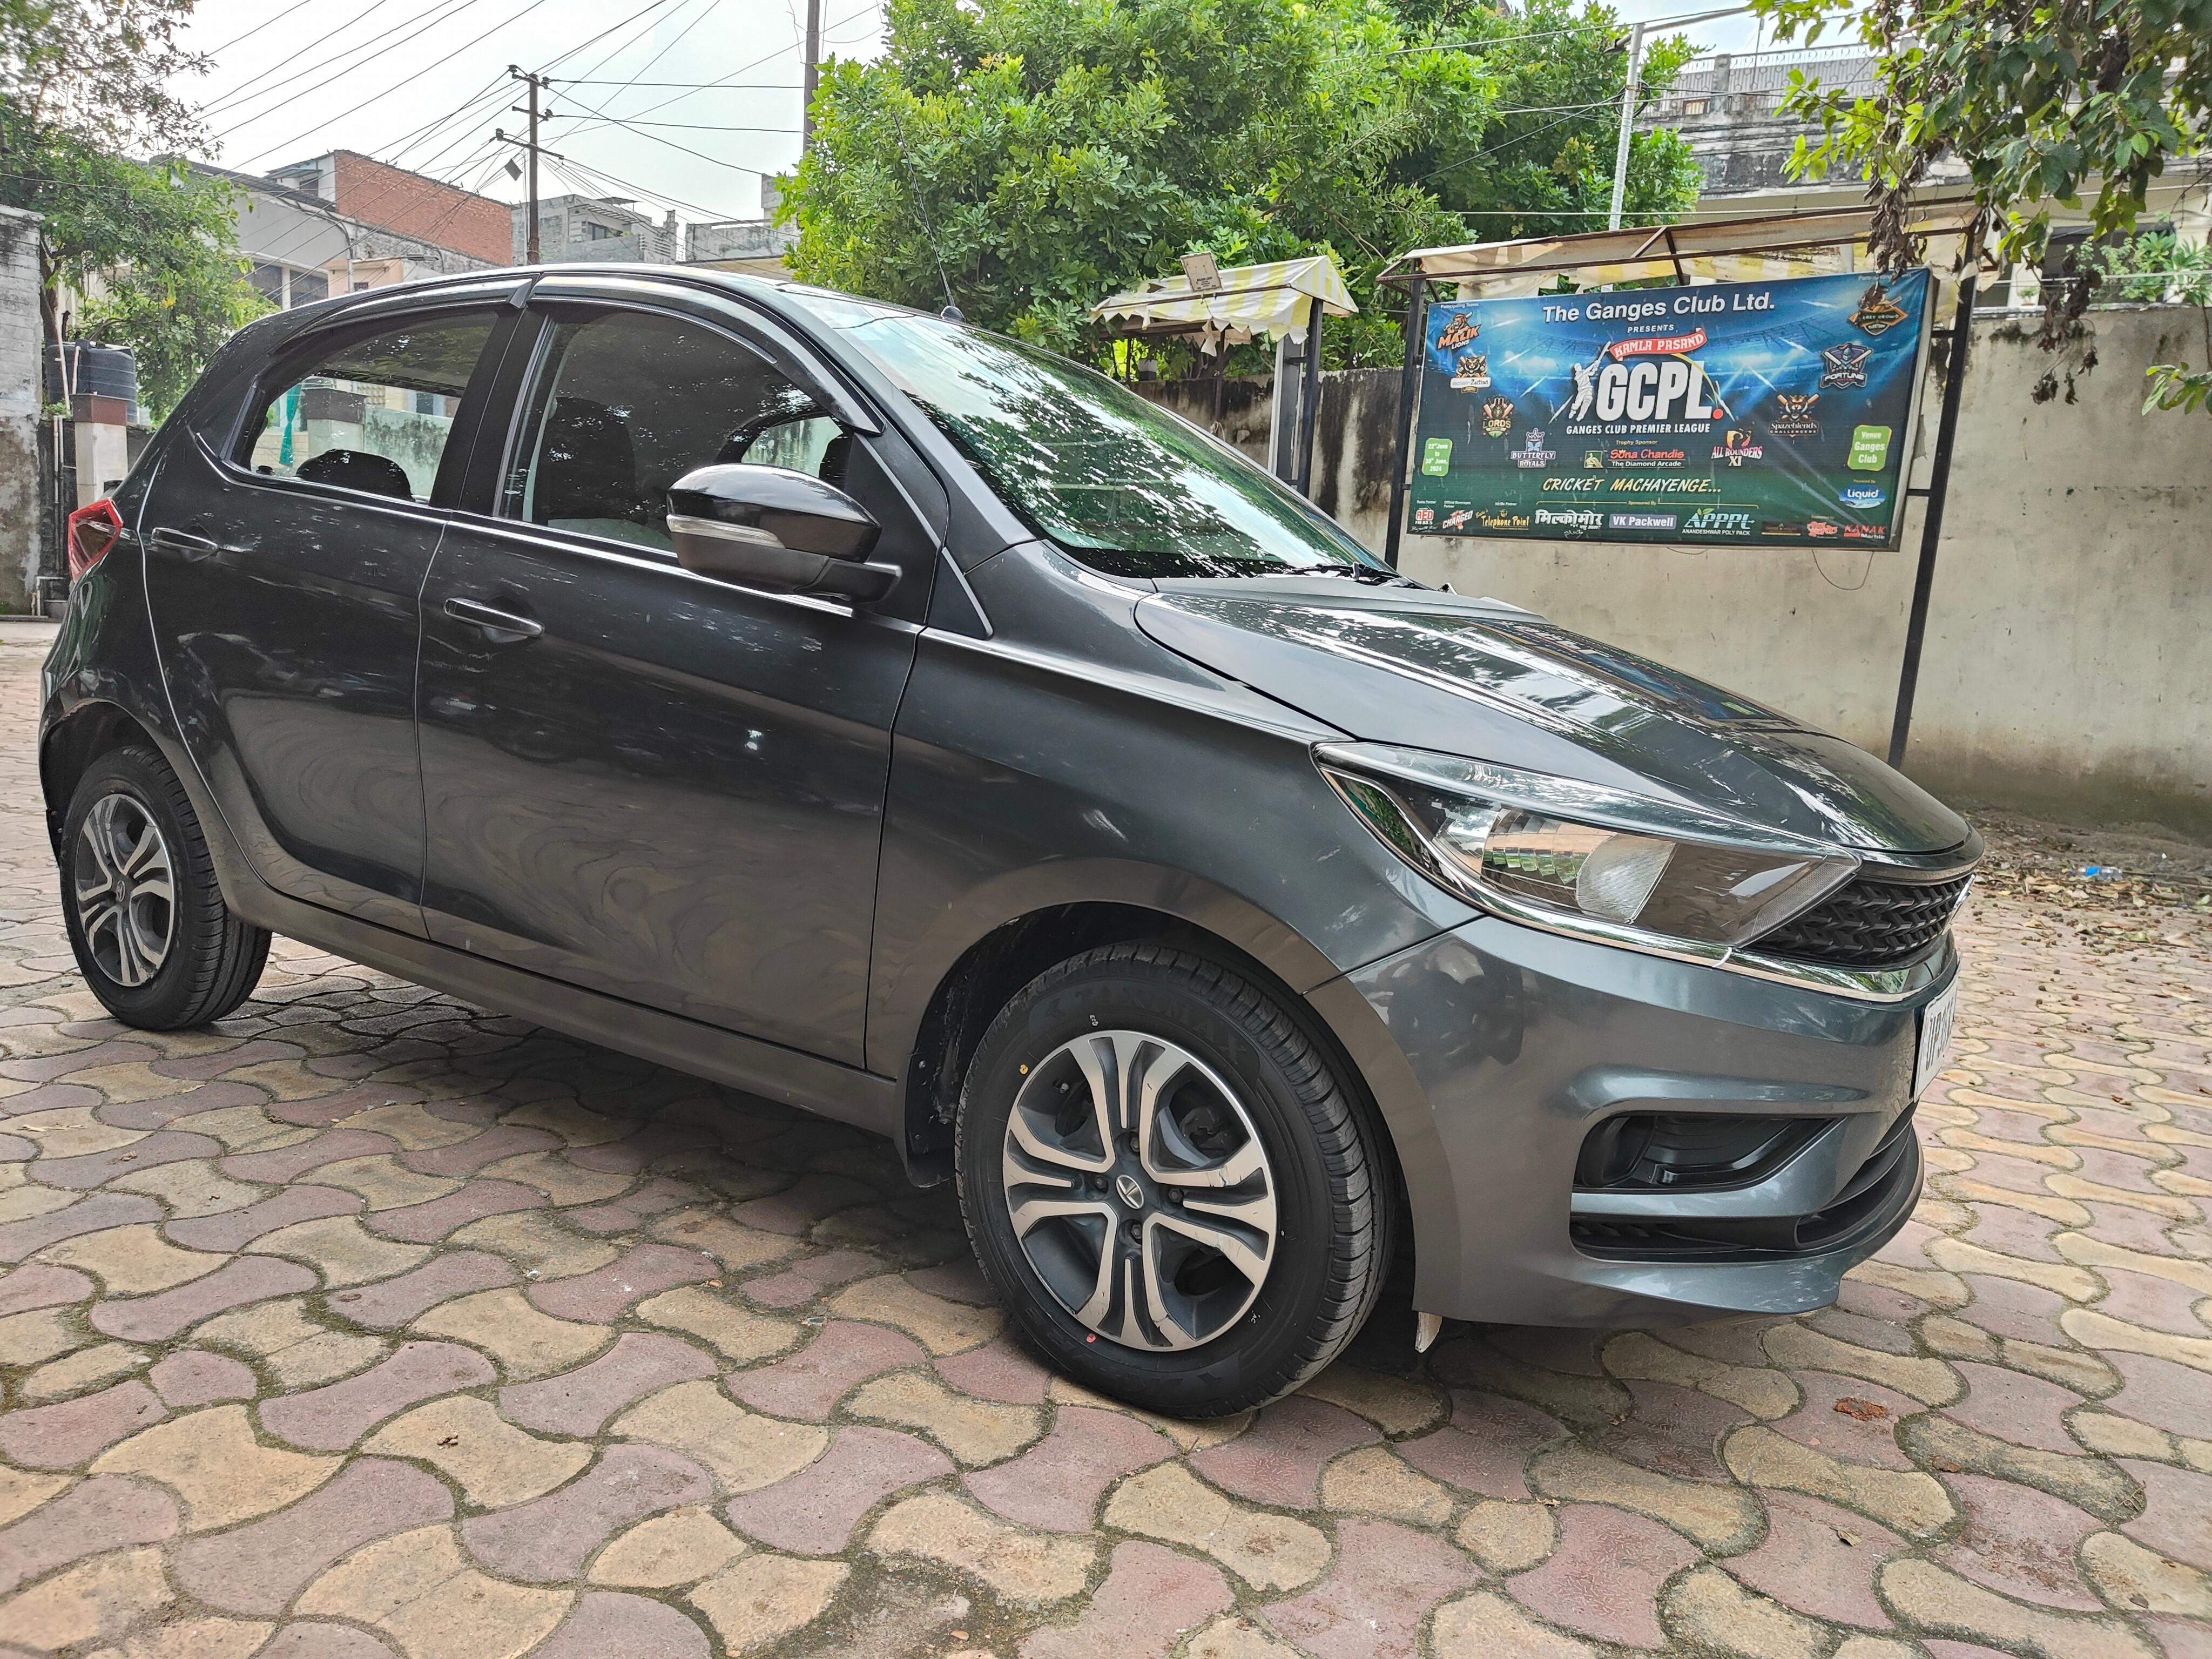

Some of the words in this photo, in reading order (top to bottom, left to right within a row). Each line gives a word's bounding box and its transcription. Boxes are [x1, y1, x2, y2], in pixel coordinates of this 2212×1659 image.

[1543, 306, 1580, 322] The
[1586, 302, 1666, 322] Ganges
[1674, 295, 1725, 313] Club
[1733, 292, 1775, 311] Ltd.
[1627, 325, 1674, 333] PRESENTS
[1438, 326, 1480, 349] MALIK
[1452, 339, 1469, 349] LIONS
[1614, 340, 1652, 358] KAMLA
[1657, 334, 1704, 351] PASAND
[1596, 360, 1713, 421] GCPL
[1482, 420, 1511, 429] LORDS
[1566, 425, 1602, 435] GANGES
[1605, 424, 1627, 434] CLUB
[1630, 424, 1671, 434] PREMIER
[1674, 423, 1710, 433] LEAGUE
[1711, 446, 1724, 459] ALL
[1725, 446, 1763, 459] ROUNDERS
[1854, 441, 1885, 453] Ganges
[1610, 449, 1638, 458] Sona
[1641, 449, 1684, 458] Chandis
[1858, 454, 1877, 463] Club
[1728, 456, 1742, 466] XI
[1543, 478, 1605, 491] CRICKET
[1610, 478, 1722, 493] MACHAYENGE...
[1847, 488, 1879, 500] Liquid
[1417, 510, 1433, 520] RED
[1442, 510, 1473, 529] CHARGED
[1481, 515, 1510, 529] Telephone
[1512, 515, 1529, 526] Point
[1613, 516, 1627, 525] VK
[1629, 517, 1674, 527] Packwell
[1845, 524, 1886, 534] KANAK
